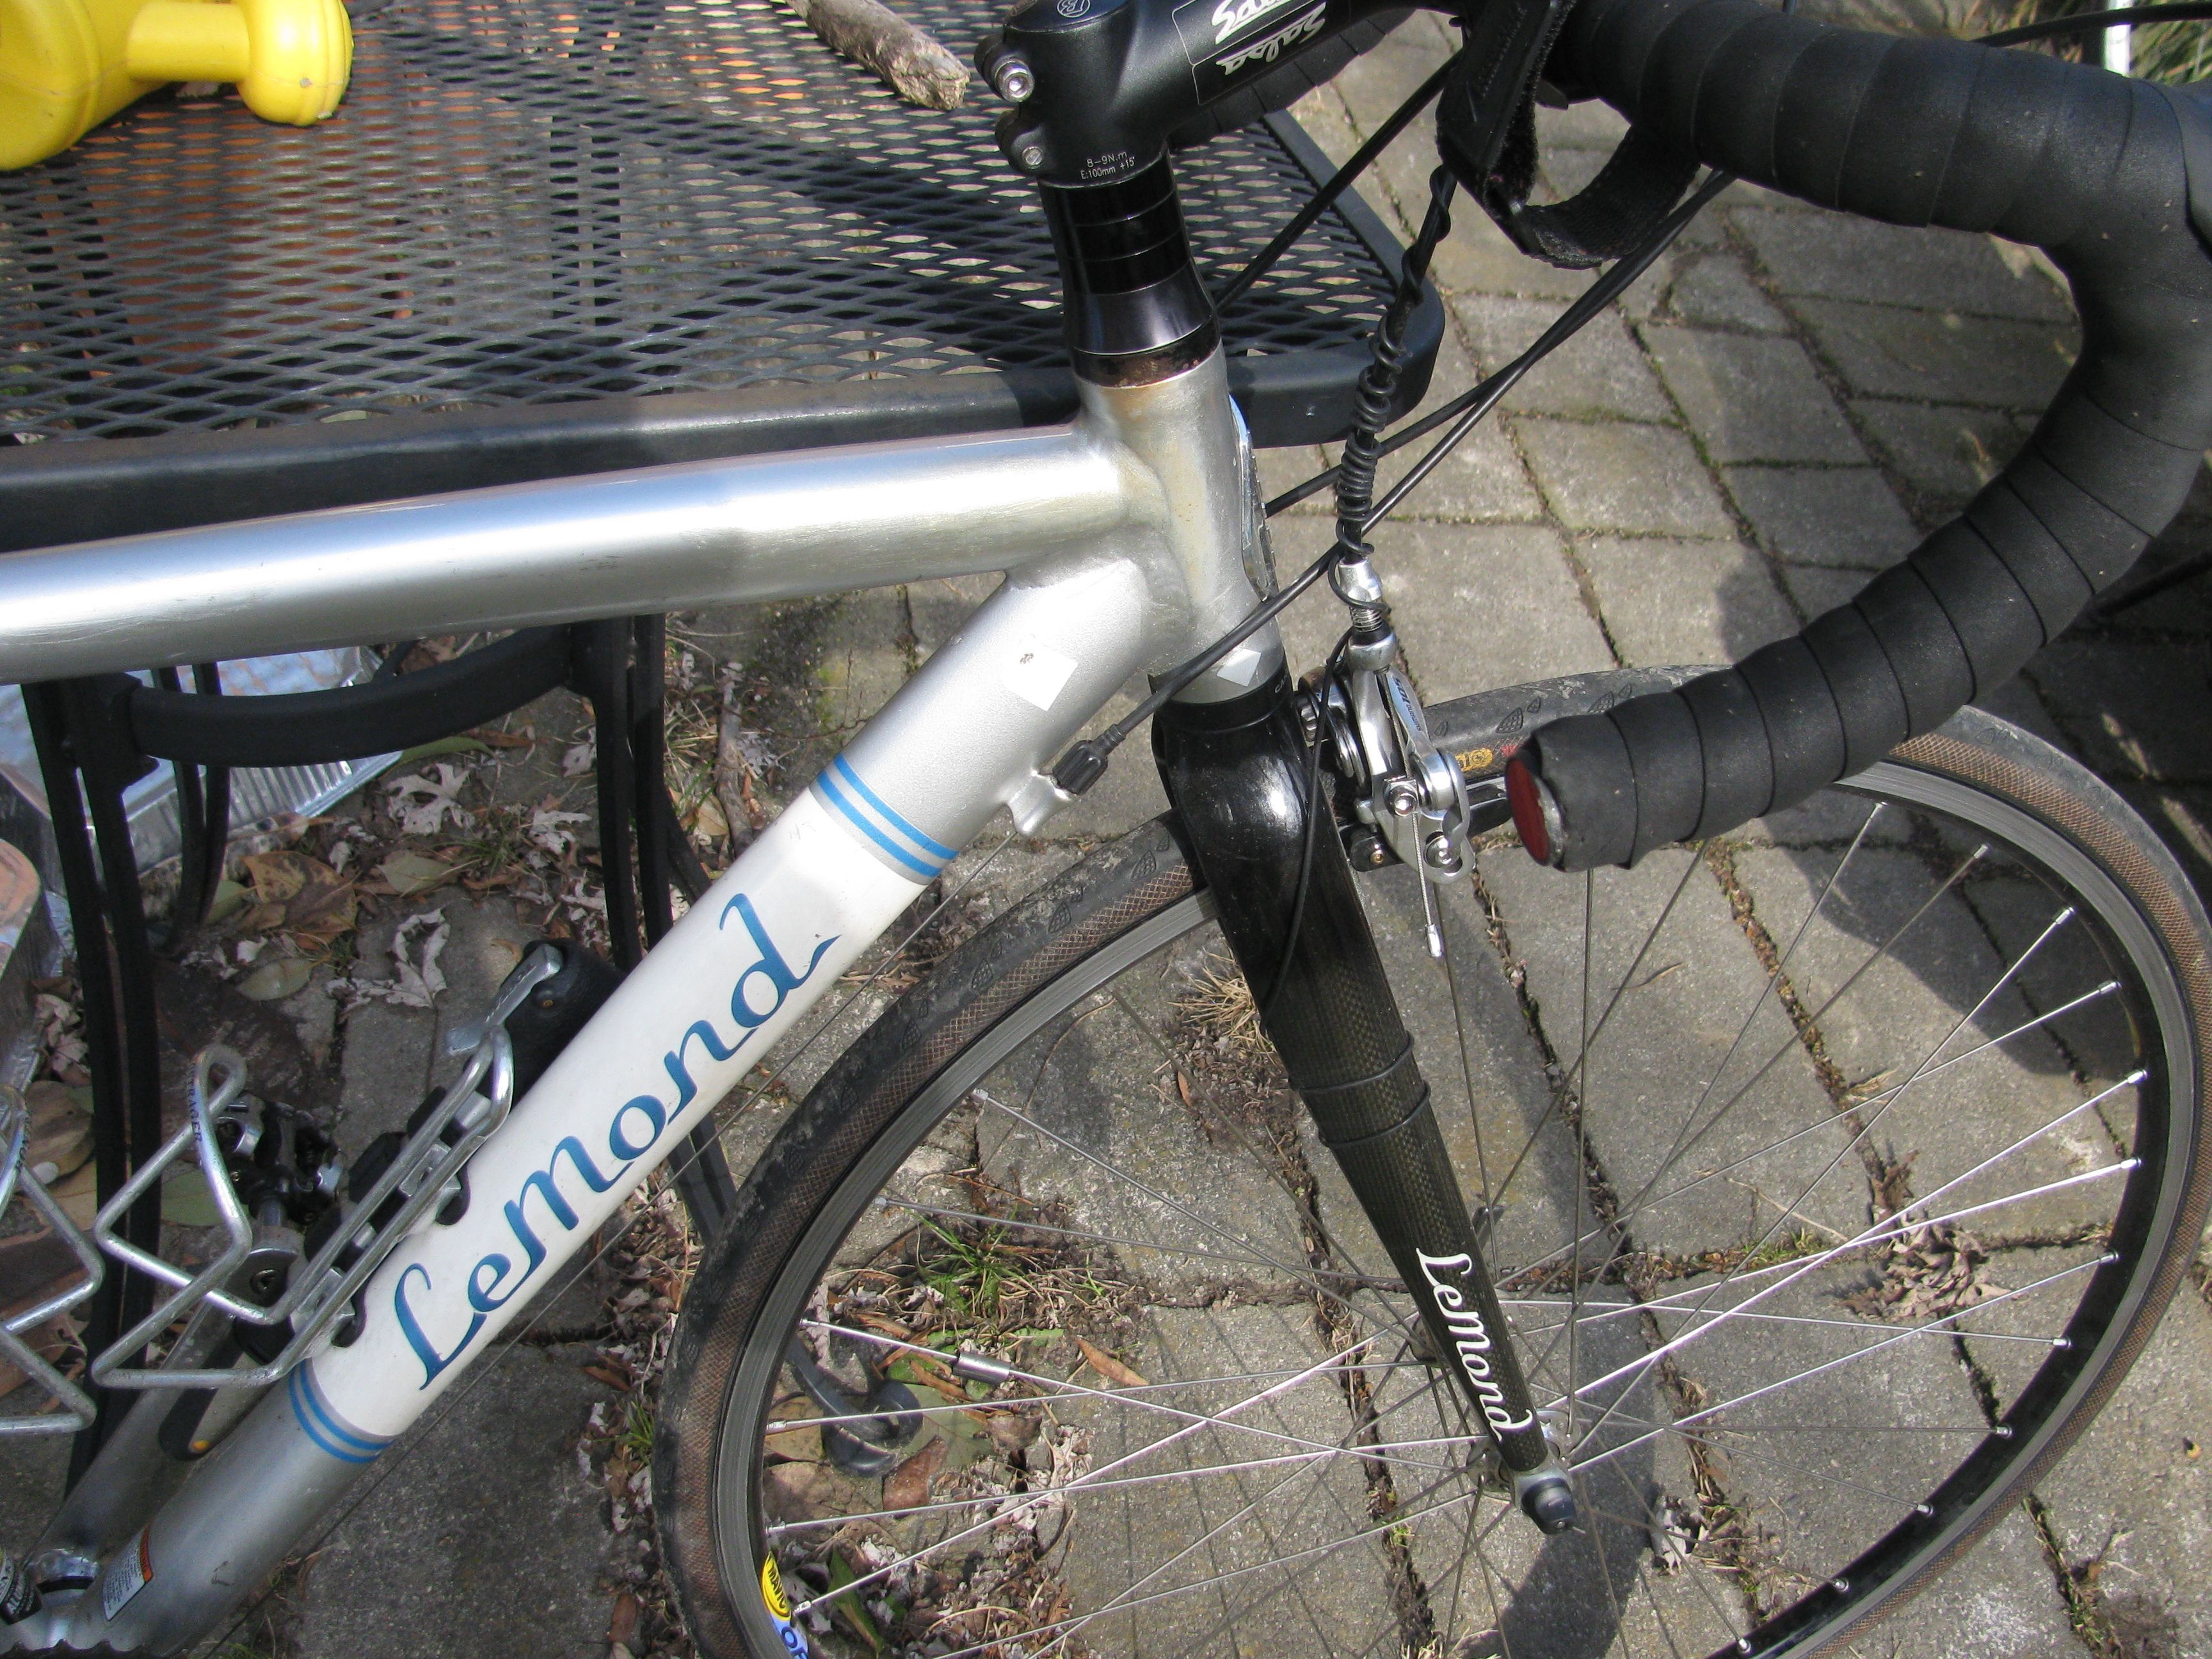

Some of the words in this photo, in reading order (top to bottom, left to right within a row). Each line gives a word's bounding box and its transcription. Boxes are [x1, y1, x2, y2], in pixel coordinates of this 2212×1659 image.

[1215, 2, 1326, 76] Salsa
[1393, 676, 1411, 705] 105
[767, 1563, 787, 1609] MAVIC
